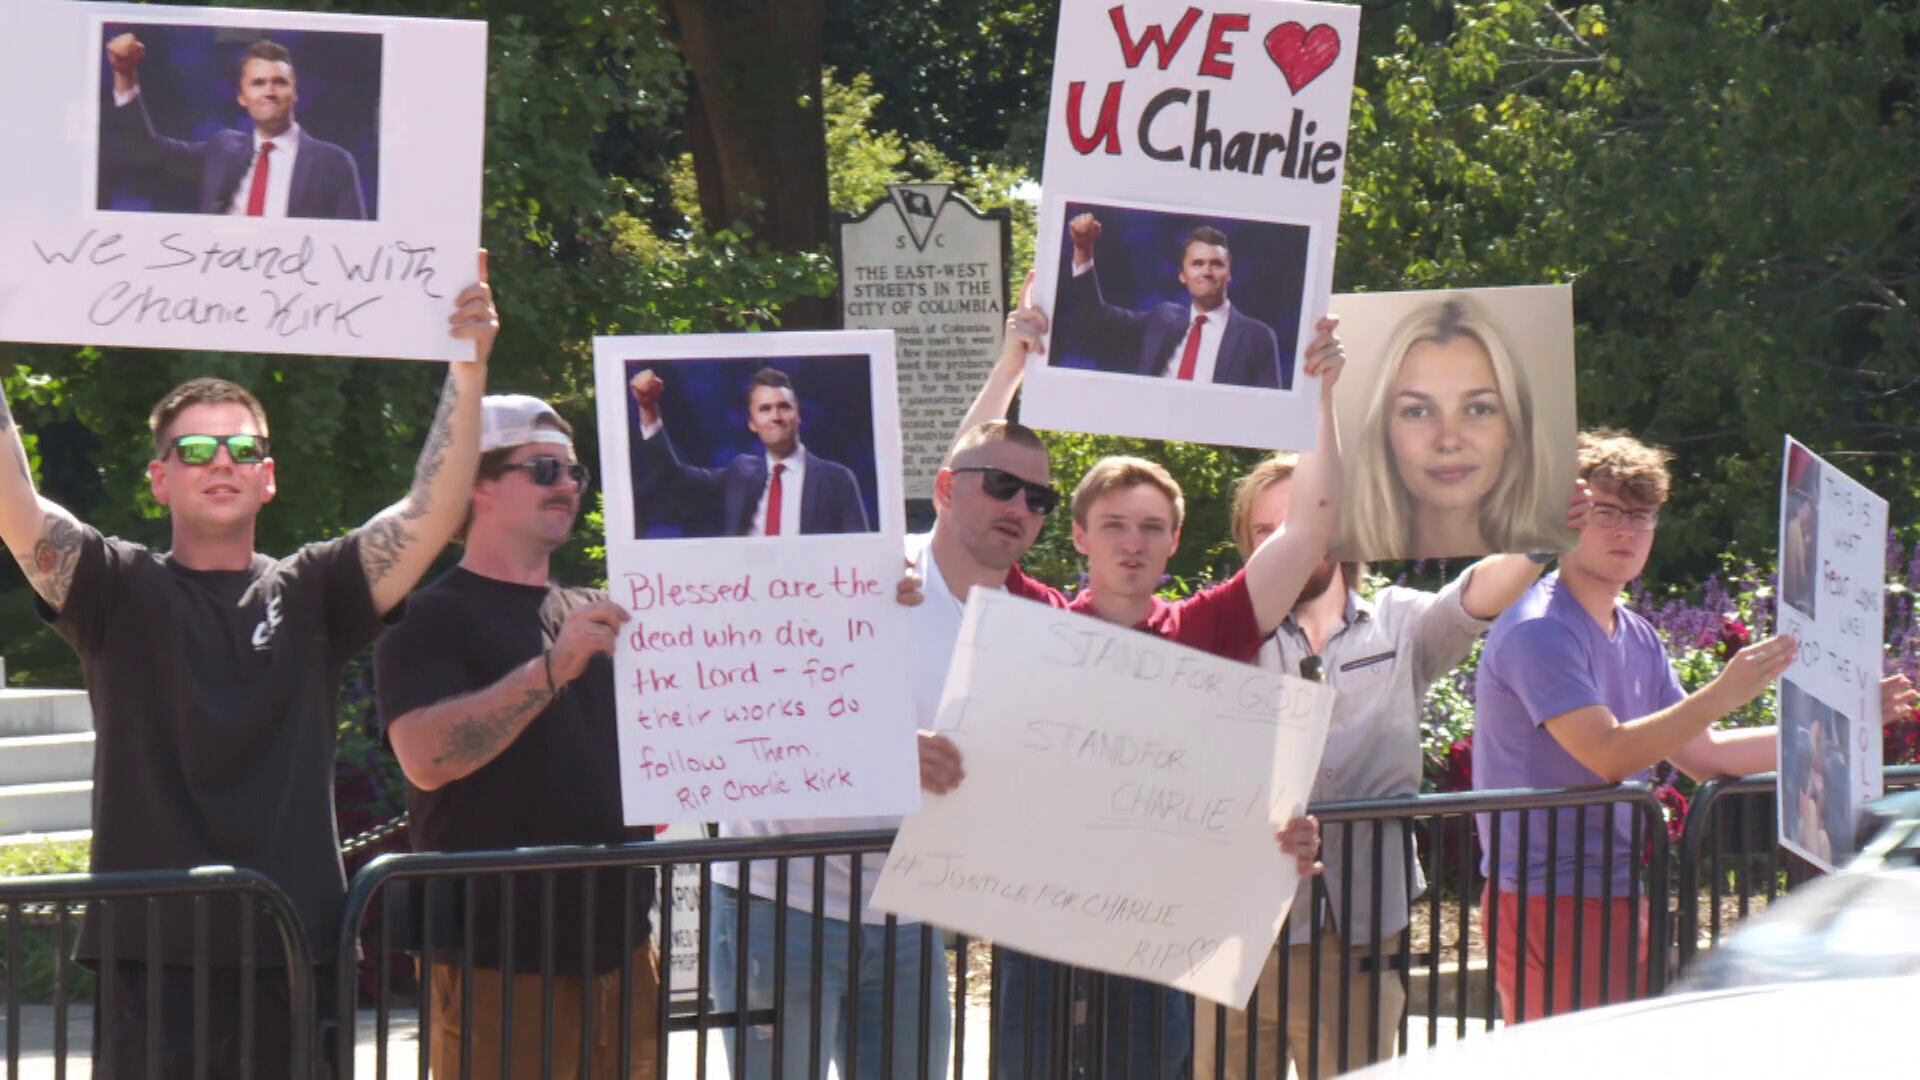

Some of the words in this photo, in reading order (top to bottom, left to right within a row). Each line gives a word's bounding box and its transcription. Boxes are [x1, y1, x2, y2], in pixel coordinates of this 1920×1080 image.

[1107, 5, 1251, 80] WE
[1137, 87, 1343, 184] Charlie
[895, 235, 906, 249] S
[935, 234, 945, 248] C
[144, 233, 319, 286] Stand
[855, 266, 888, 281] THE
[895, 263, 988, 279] EAST-WEST
[854, 282, 928, 298] STREETS
[934, 281, 949, 296] IN
[958, 281, 992, 295] THE
[848, 301, 886, 316] CITY
[892, 301, 913, 315] OF
[918, 299, 1000, 315] COLUMBIA
[623, 572, 753, 611] Blessed
[767, 575, 824, 600] are
[829, 566, 884, 597] the
[629, 623, 694, 652] dead
[703, 623, 762, 648] who
[632, 667, 680, 696] the
[696, 660, 760, 690] Lord
[802, 657, 856, 688] for
[1041, 622, 1164, 681] STAND
[1170, 656, 1224, 697] FOR
[1236, 674, 1314, 719] GOD
[636, 702, 711, 730] their
[724, 699, 806, 723] works
[828, 696, 861, 719] do
[1023, 719, 1137, 767] STAND
[1138, 741, 1186, 770] FOR
[638, 745, 727, 780] follow
[723, 773, 791, 802] Charlie
[804, 767, 854, 792] Kirk
[1126, 937, 1190, 970] RIP
